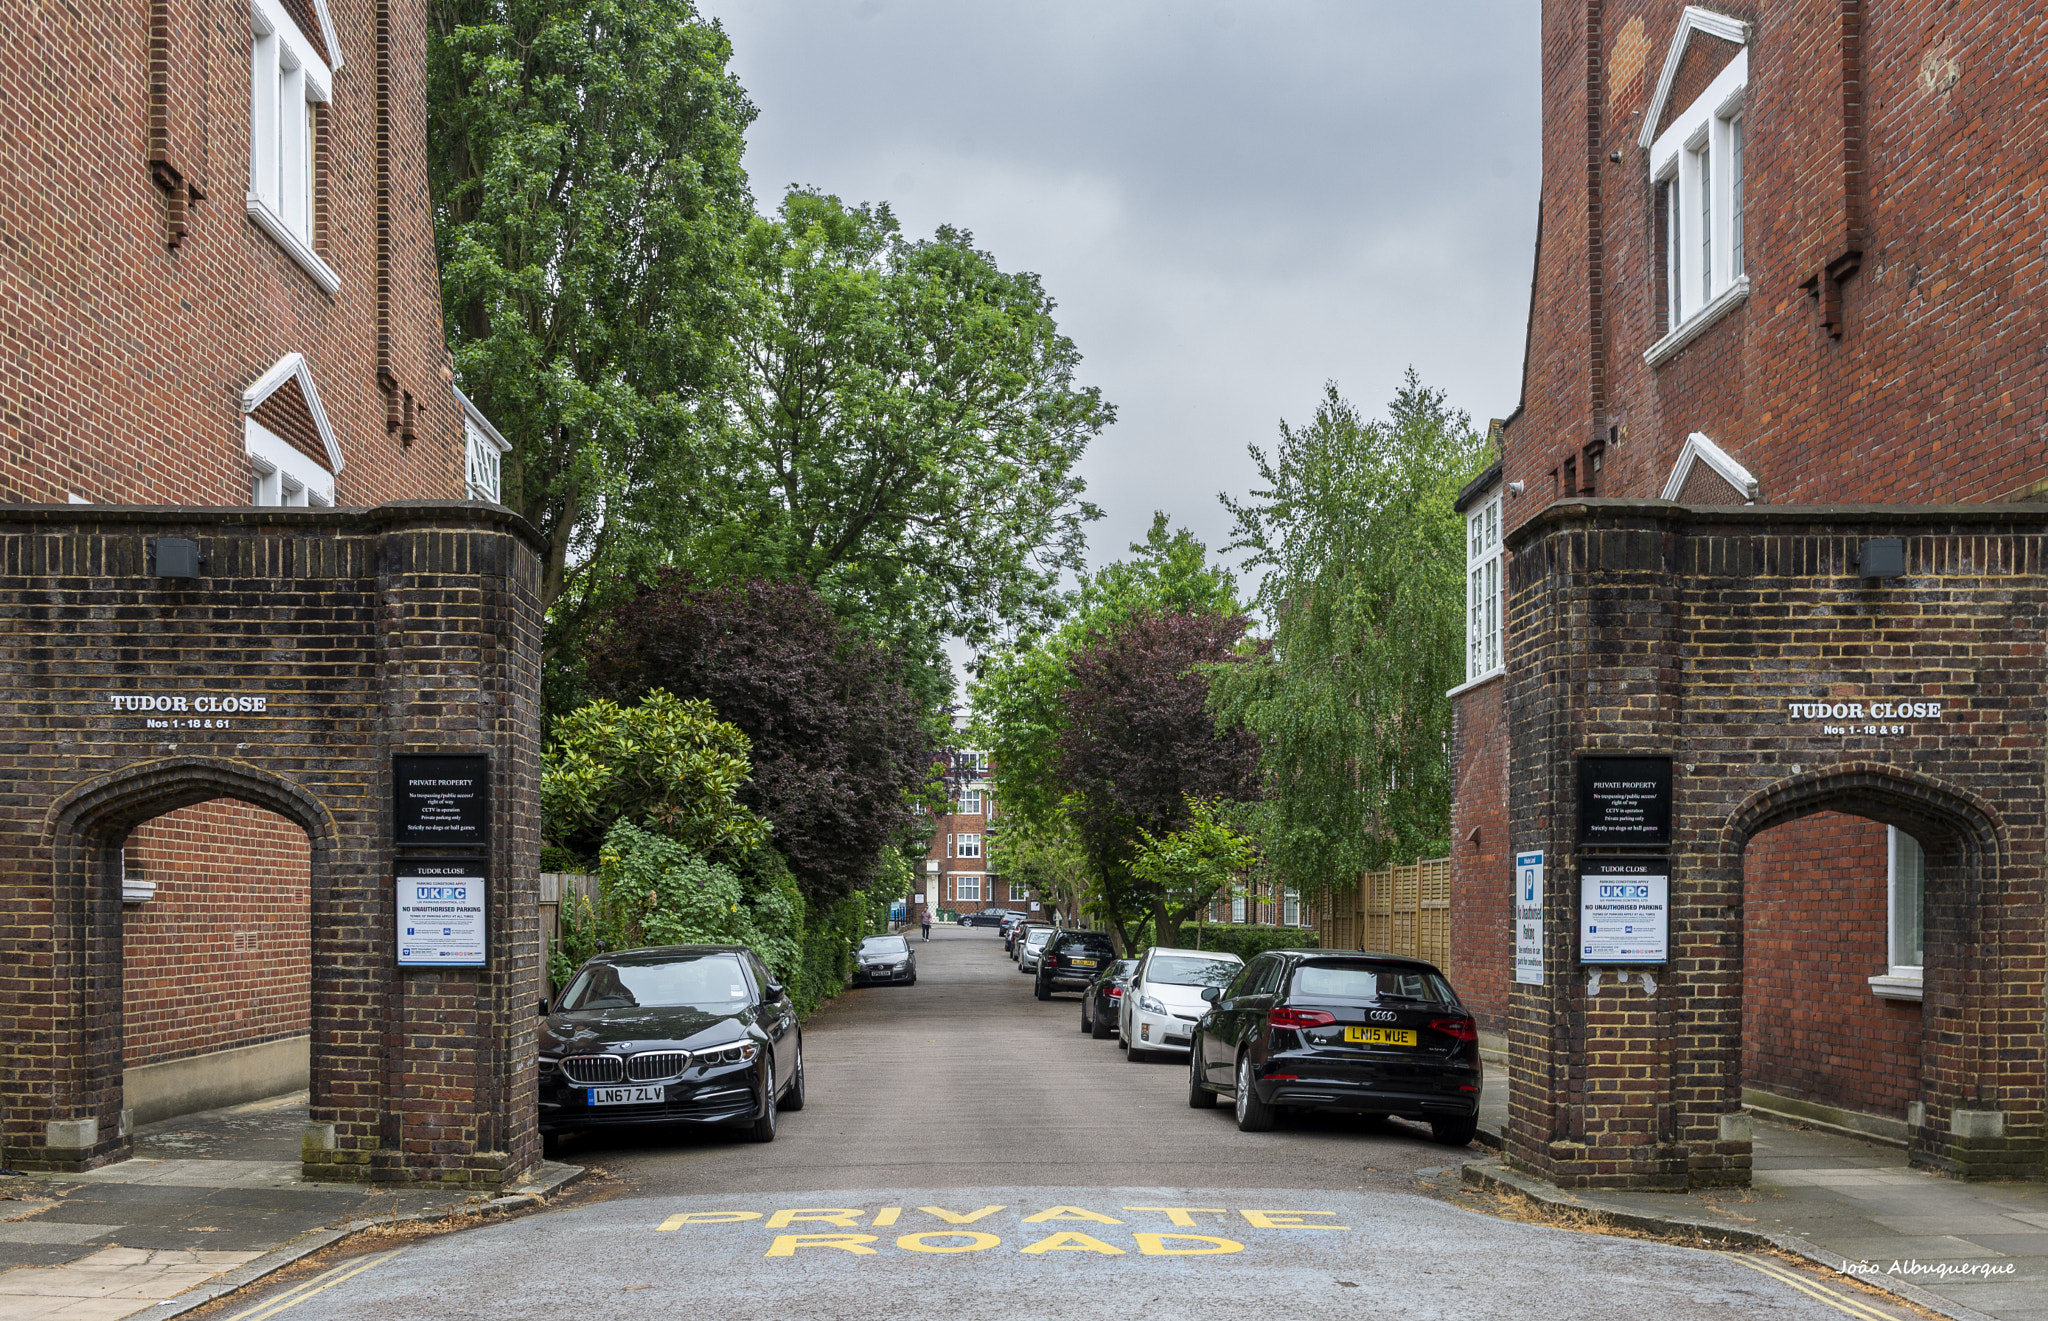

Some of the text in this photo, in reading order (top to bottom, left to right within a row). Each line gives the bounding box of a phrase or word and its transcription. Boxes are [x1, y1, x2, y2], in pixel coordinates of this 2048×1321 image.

[110, 695, 266, 712] TUDOR CLOSE
[1788, 703, 1941, 719] TUDOR CLOSE
[146, 719, 168, 728] Nos
[172, 719, 178, 728] 1
[188, 719, 201, 728] 18
[204, 719, 212, 728] &
[216, 719, 230, 728] 61
[1824, 725, 1845, 735] Nos
[1849, 725, 1854, 734] 1
[1864, 725, 1877, 734] 18
[1880, 725, 1888, 734] &
[1891, 725, 1904, 734] 61
[417, 887, 466, 899] UKPC
[1600, 885, 1648, 897] UKPC
[1523, 924, 1534, 944] Parking
[1352, 1028, 1408, 1043] LN15 WUE
[596, 1088, 662, 1103] LN67 ZLV
[654, 1204, 1352, 1231] PRIVATE
[764, 1230, 1244, 1257] ROAD
